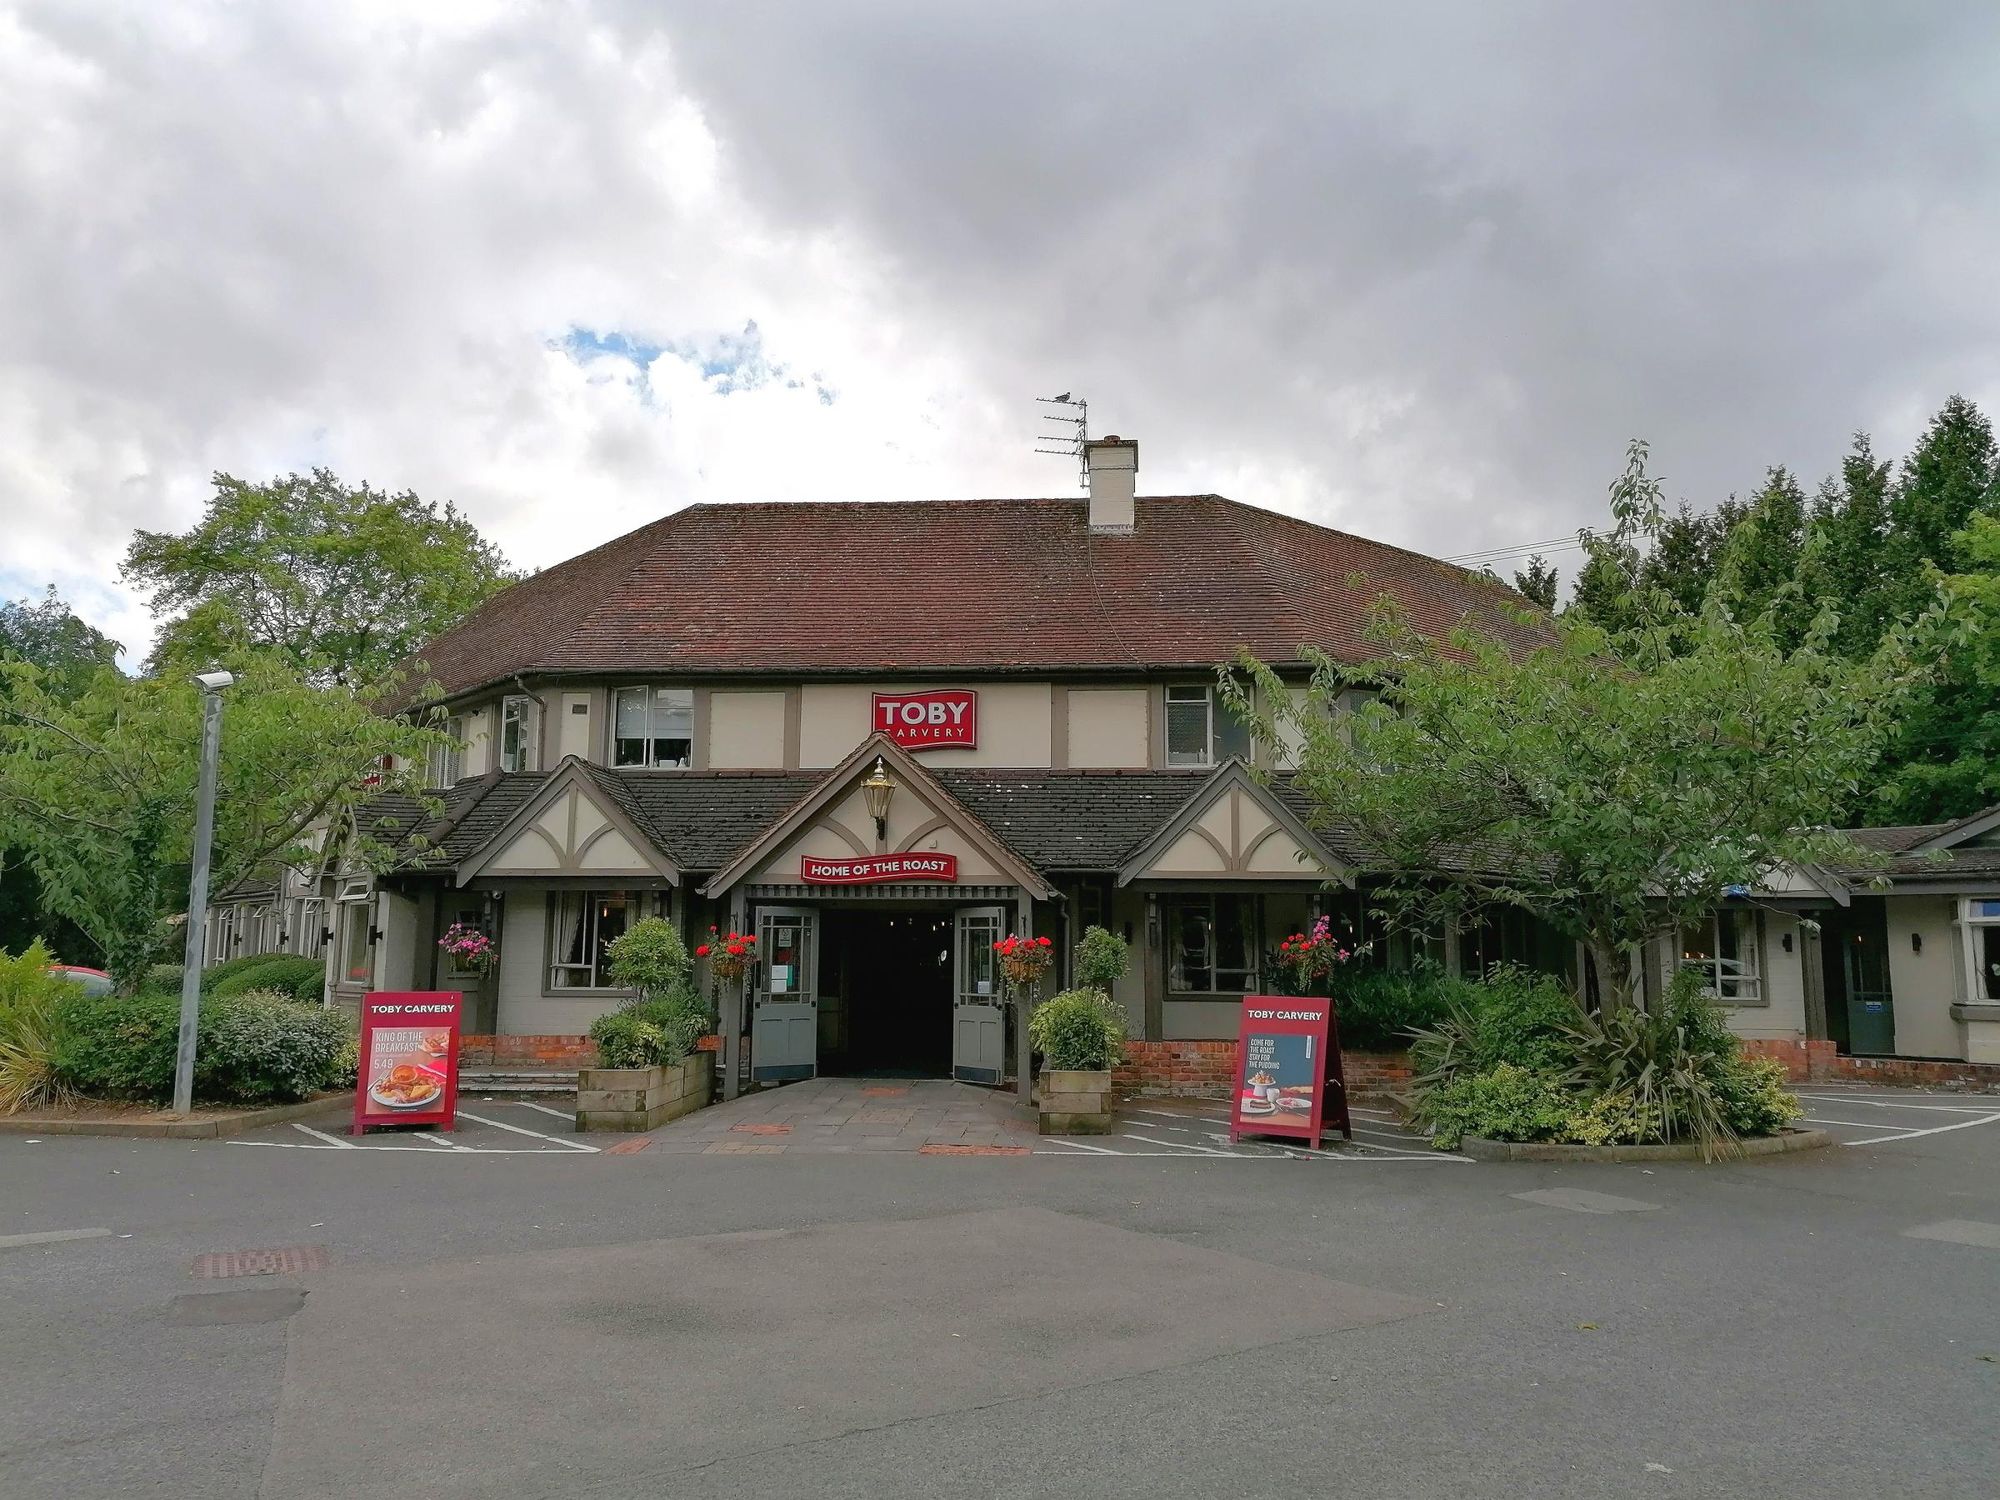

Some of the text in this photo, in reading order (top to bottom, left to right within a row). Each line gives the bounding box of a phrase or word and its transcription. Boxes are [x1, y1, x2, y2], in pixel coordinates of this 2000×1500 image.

[879, 702, 968, 725] TOBY
[811, 860, 947, 876] HOME OF THE ROAST
[371, 1004, 455, 1014] TOBY CARVERY
[1248, 1010, 1322, 1021] TOBY CARVERY
[376, 1031, 424, 1042] KING OF THE
[375, 1042, 419, 1053] BREAKFAST
[1264, 1039, 1274, 1047] FOR
[1249, 1060, 1258, 1068] THE
